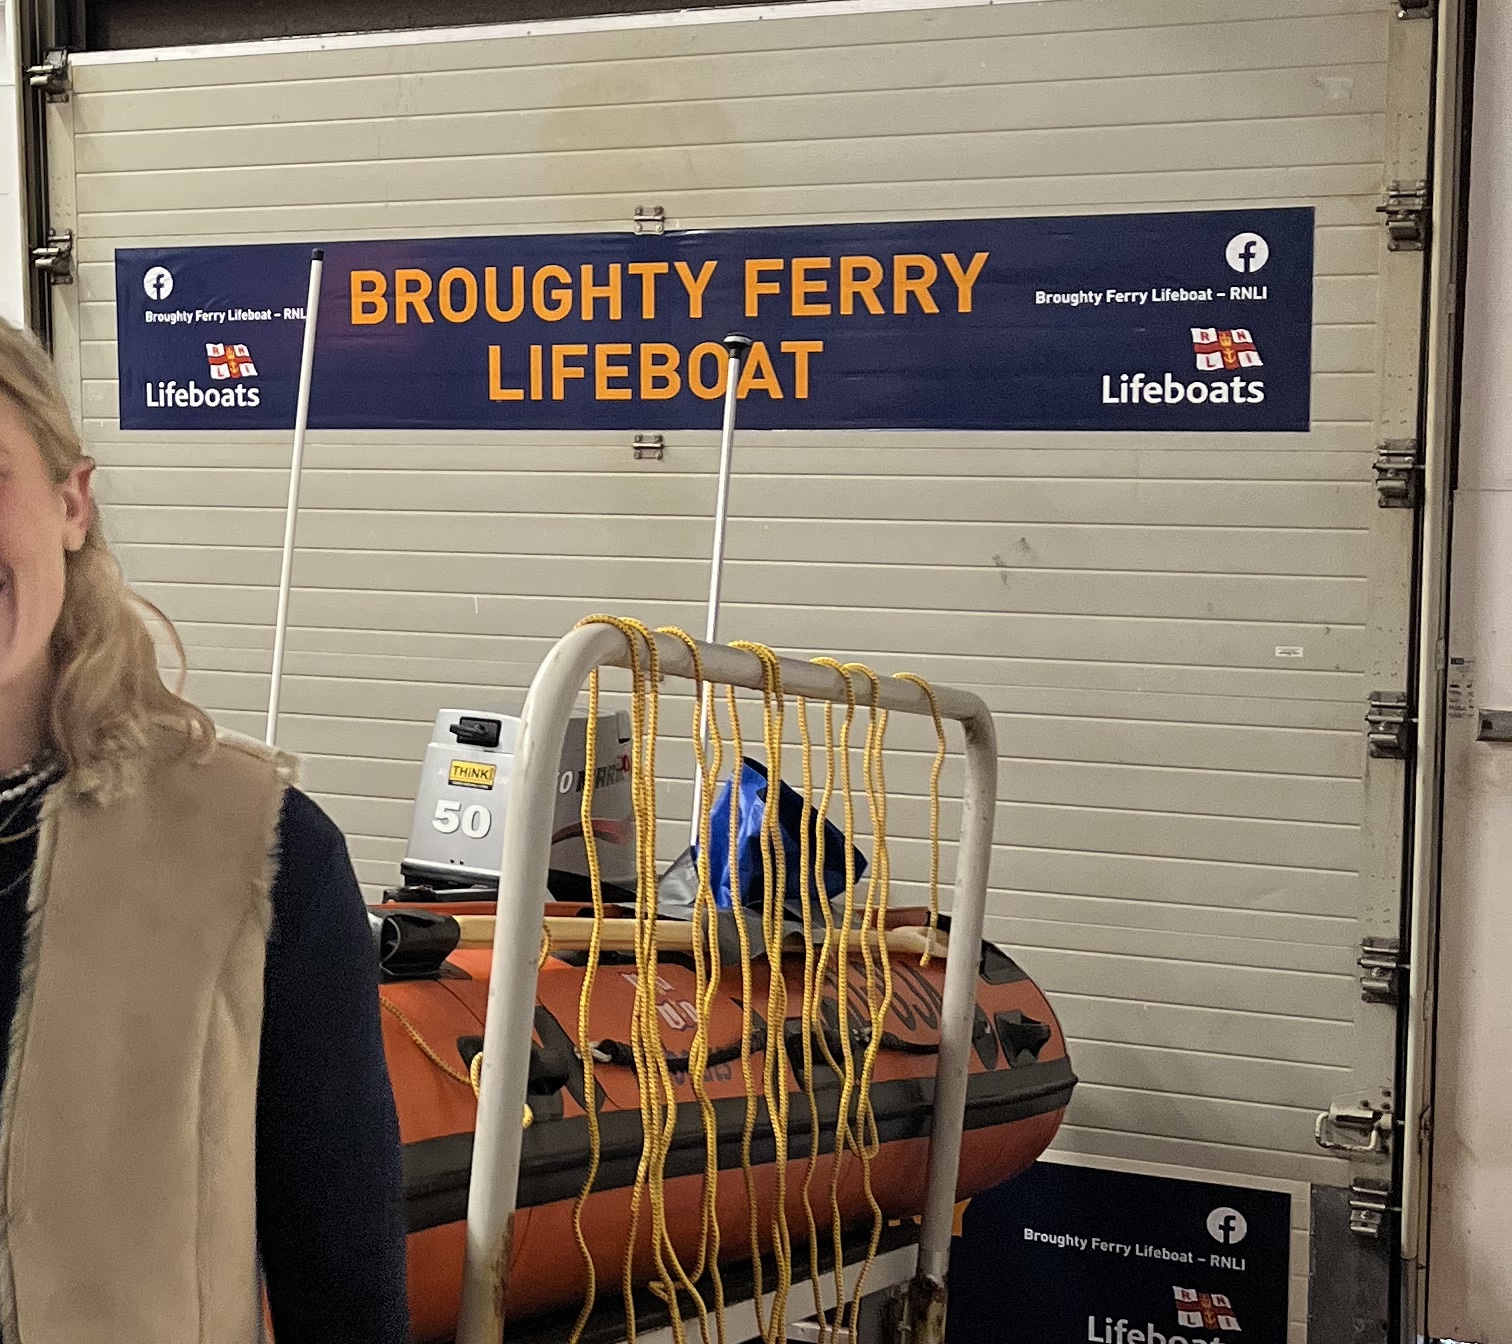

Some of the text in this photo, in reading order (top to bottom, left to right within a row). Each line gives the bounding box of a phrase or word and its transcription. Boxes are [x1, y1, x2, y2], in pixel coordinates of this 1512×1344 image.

[350, 252, 990, 325] BROUGHTY FERRY
[1035, 290, 1103, 306] Broughty
[1106, 289, 1148, 305] Ferry
[1152, 288, 1213, 302] Lifeboat
[1230, 286, 1268, 300] RNLI
[145, 310, 193, 325] Broughty
[195, 310, 226, 324] Ferry
[228, 308, 272, 321] Lifeboat
[283, 308, 308, 320] RNL
[488, 341, 824, 402] LIFEBOAT
[1102, 372, 1265, 404] Lifeboats
[145, 380, 261, 408] Lifeboats
[431, 799, 493, 840] 50
[1024, 1227, 1088, 1251] Broughty
[1091, 1237, 1132, 1257] Ferry
[1135, 1243, 1193, 1263] Lifeboat
[1210, 1254, 1246, 1271] RNLI
